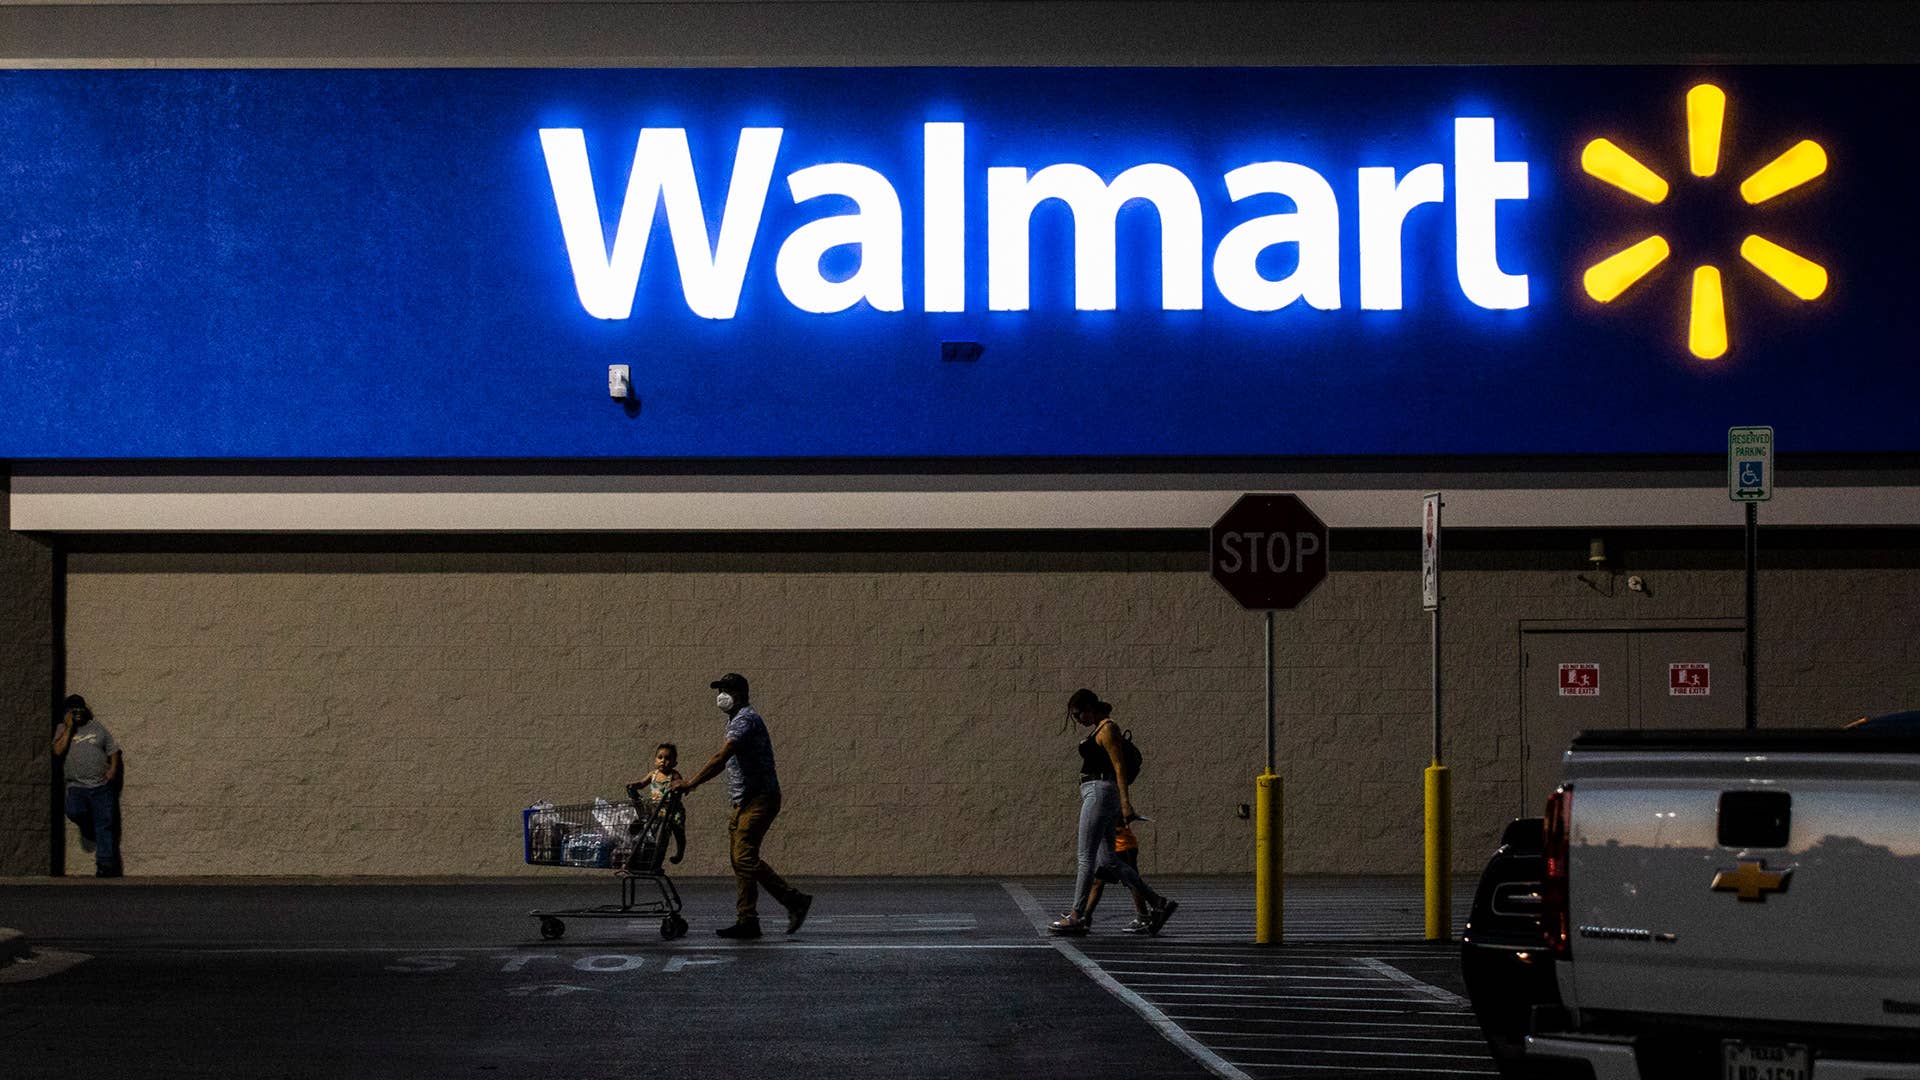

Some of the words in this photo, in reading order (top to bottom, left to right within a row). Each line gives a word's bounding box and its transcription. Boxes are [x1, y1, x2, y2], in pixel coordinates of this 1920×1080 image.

[538, 116, 1530, 320] Walmart
[1732, 433, 1770, 444] RESERVED
[1736, 446, 1767, 457] PARKING
[1219, 531, 1319, 574] STOP
[1563, 687, 1577, 695] FIRE
[1578, 687, 1596, 695] EXITS
[1673, 687, 1687, 695] FIRE
[1688, 687, 1706, 695] EXITS
[384, 954, 738, 973] STOP
